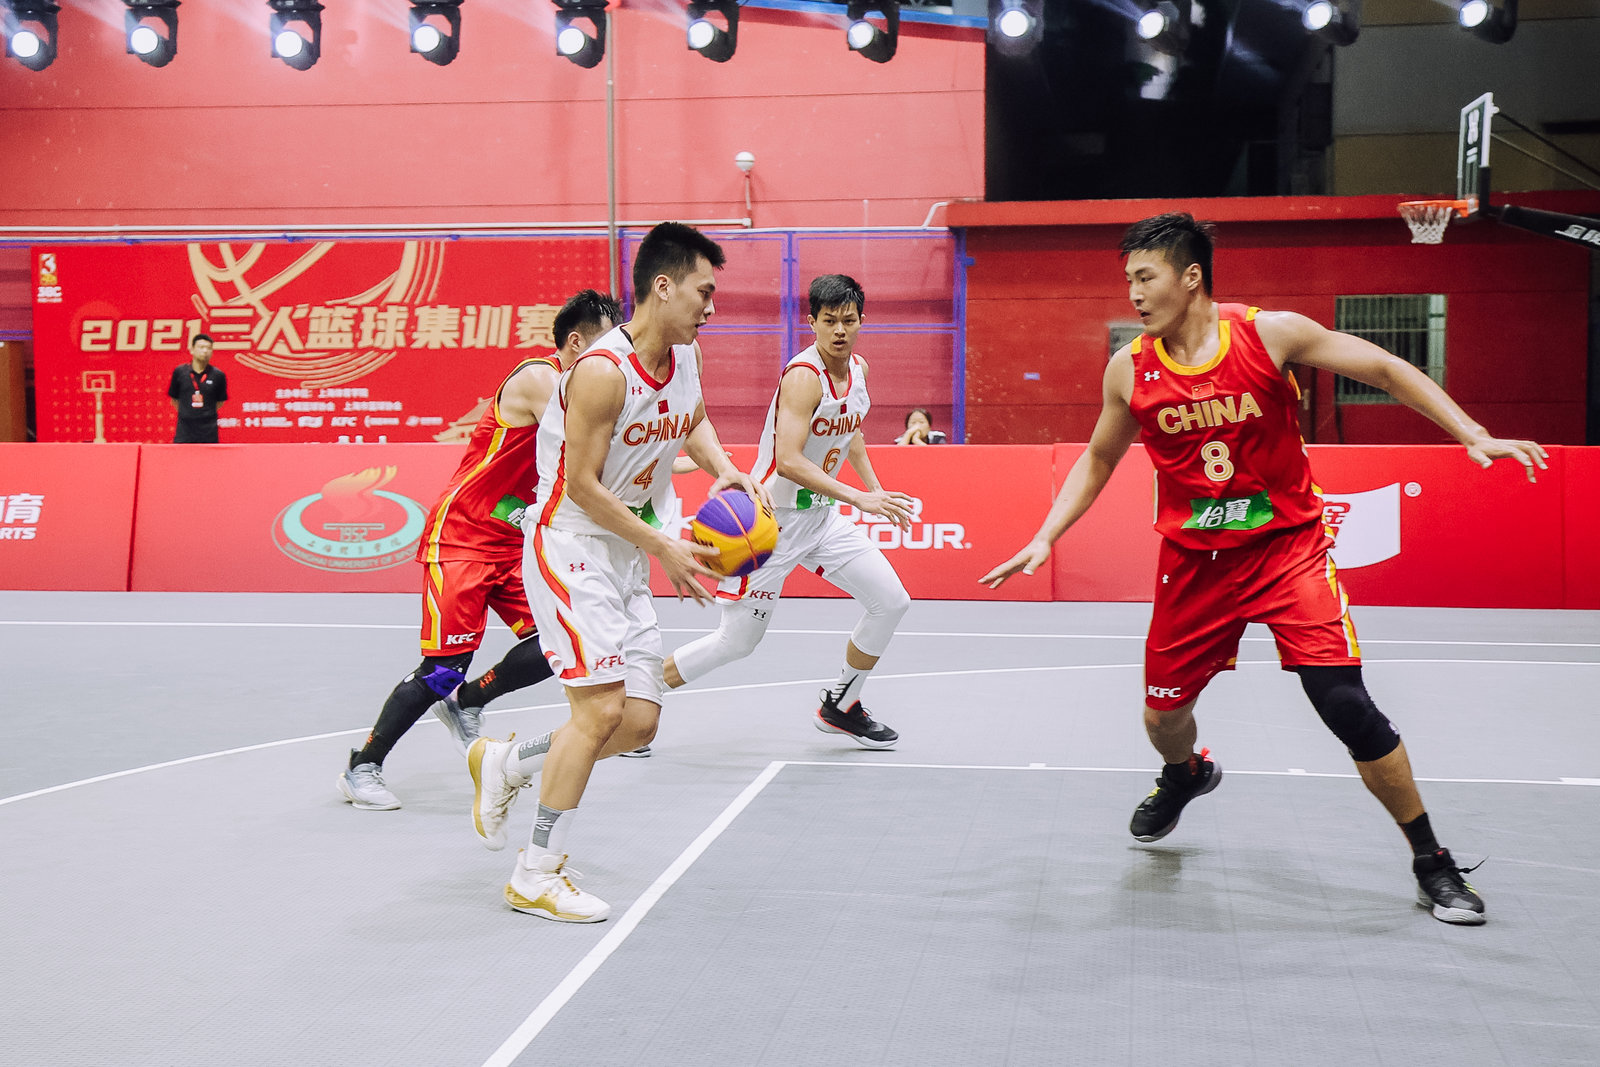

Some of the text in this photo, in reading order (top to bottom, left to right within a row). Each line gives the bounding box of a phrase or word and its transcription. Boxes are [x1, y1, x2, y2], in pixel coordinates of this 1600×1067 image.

[811, 413, 862, 437] CHINA
[1157, 391, 1263, 434] CHINA
[623, 413, 691, 447] CHINA
[633, 458, 660, 491] 4
[822, 447, 841, 475] 6
[1200, 440, 1235, 482] 8
[0, 493, 45, 524] 育
[859, 523, 965, 549] OUR
[749, 590, 776, 601] KFC
[445, 632, 476, 645] KFC
[593, 655, 625, 671] KFC
[1147, 685, 1181, 699] KFC
